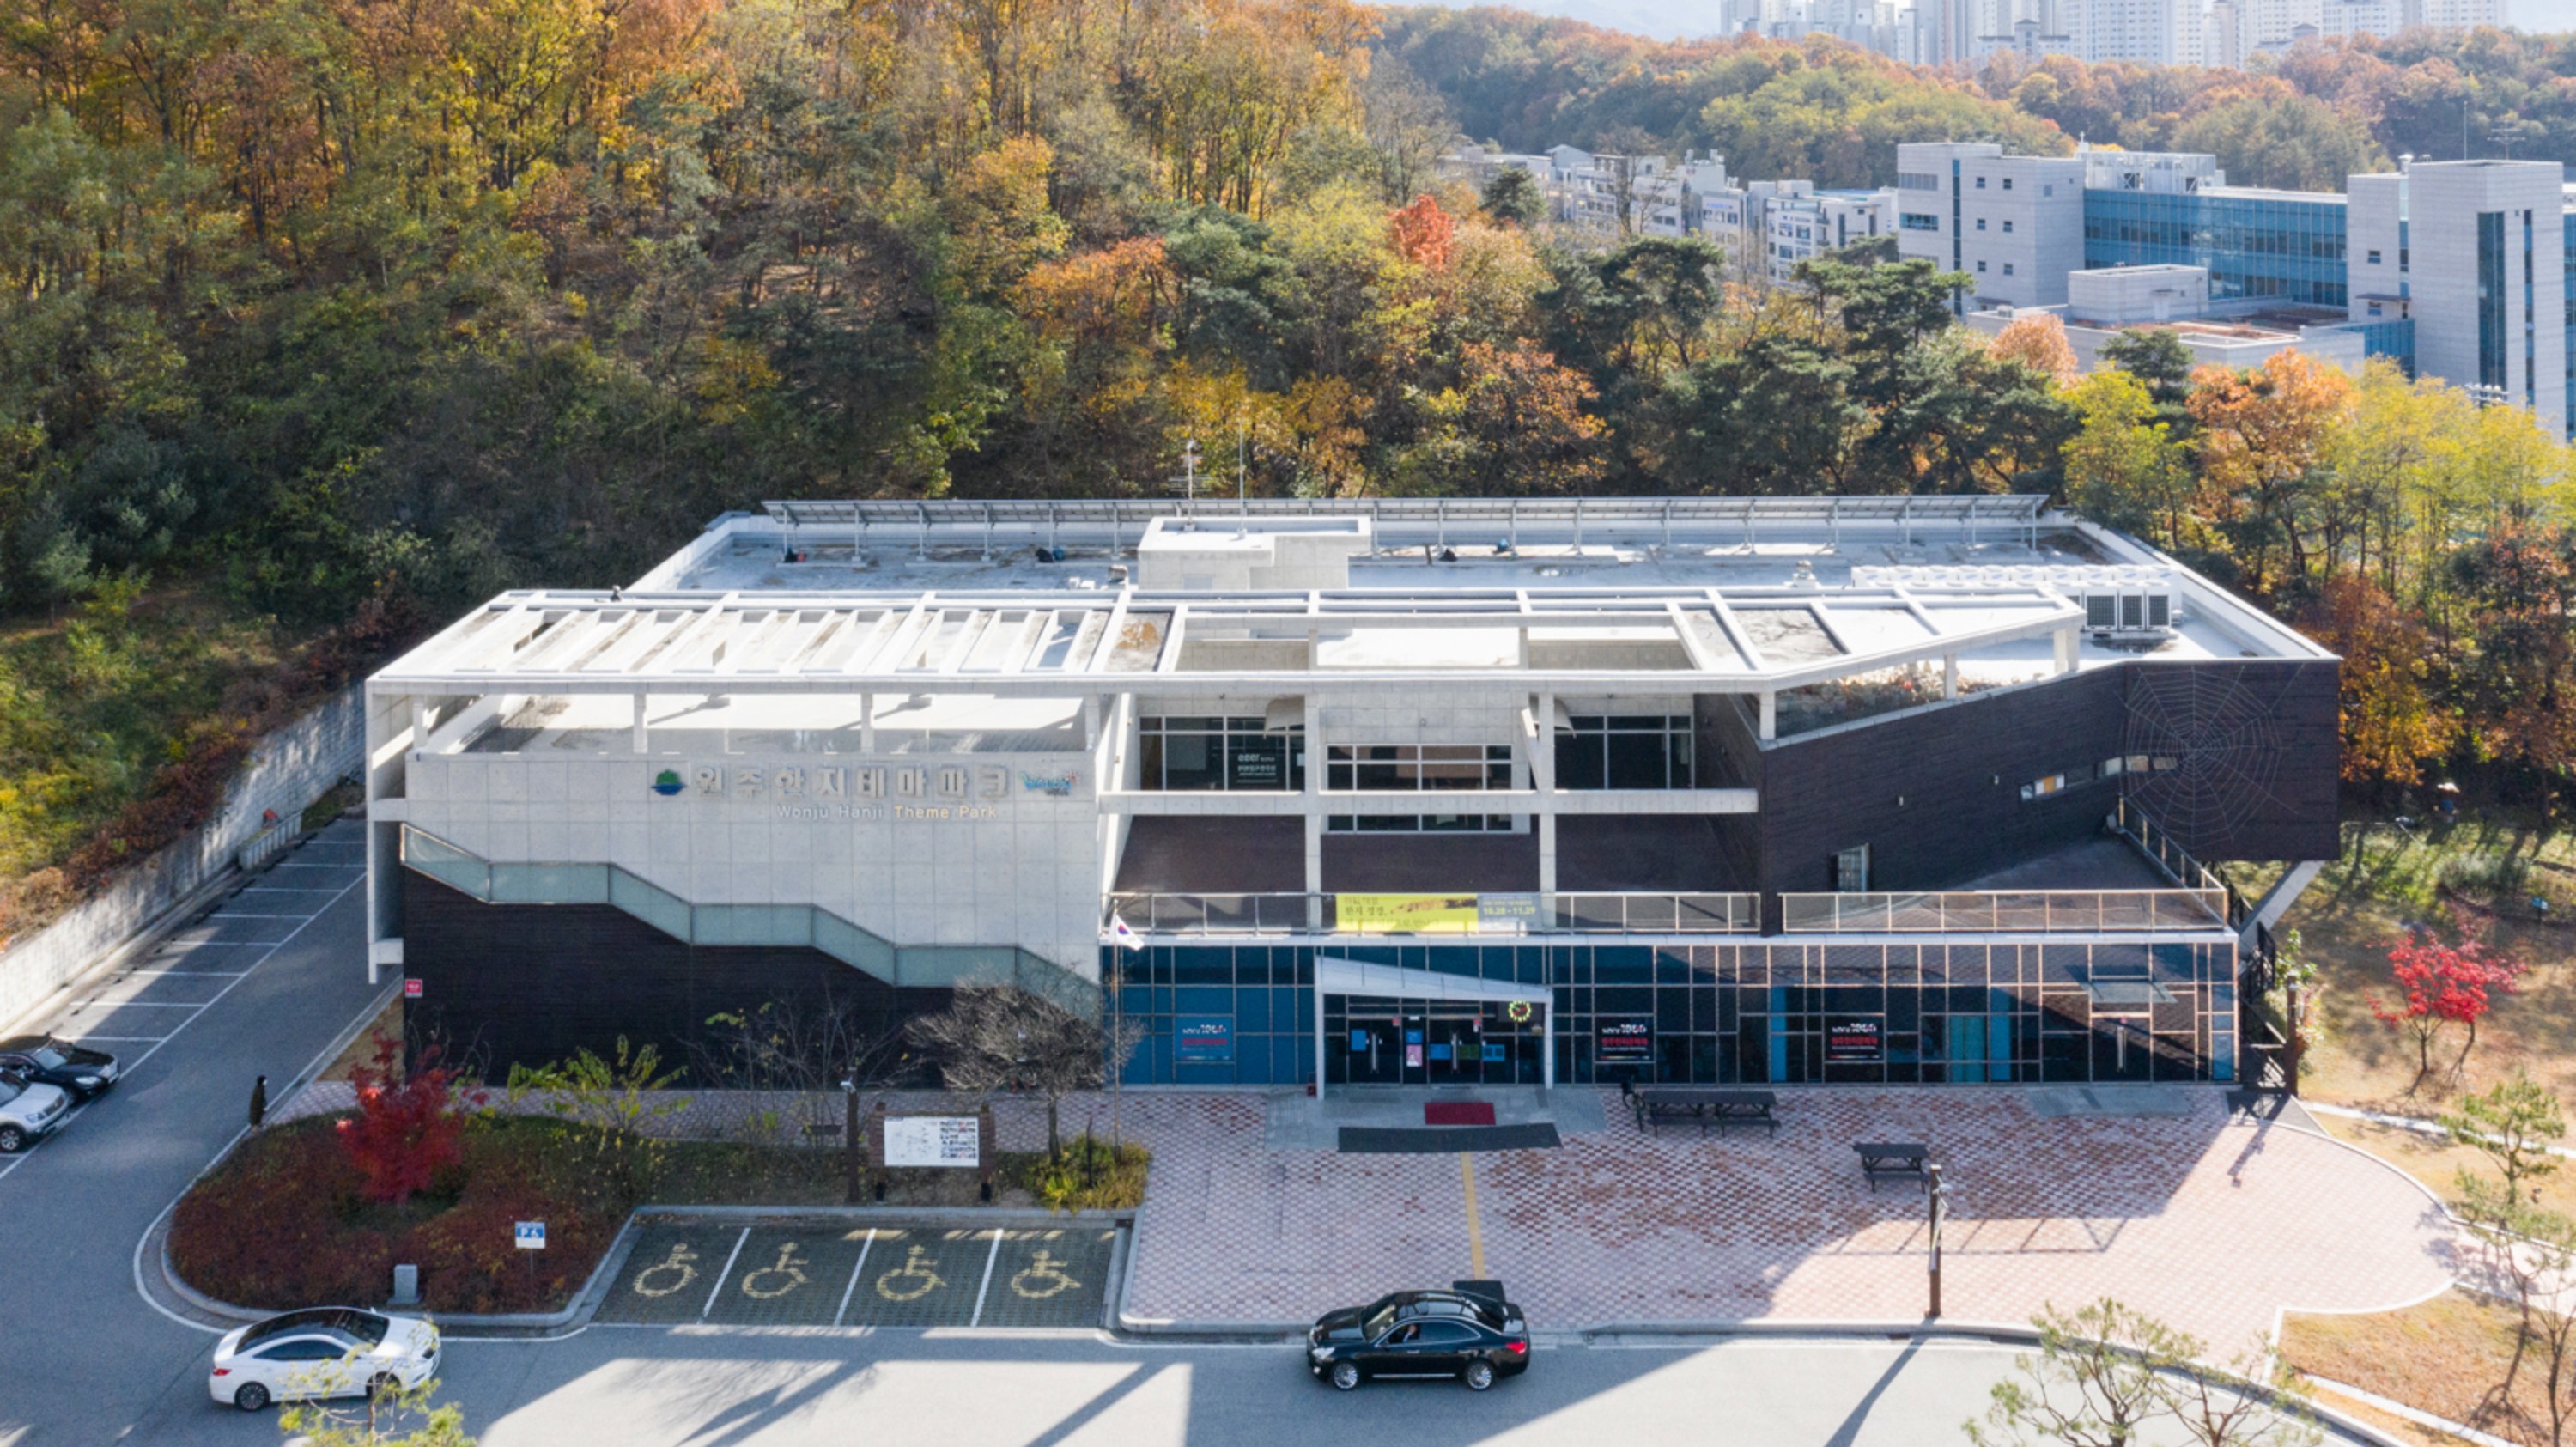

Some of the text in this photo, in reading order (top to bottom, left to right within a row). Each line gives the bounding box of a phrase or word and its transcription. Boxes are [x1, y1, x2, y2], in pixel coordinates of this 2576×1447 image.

[777, 805, 998, 820] Wonju Hanji Theme Park
